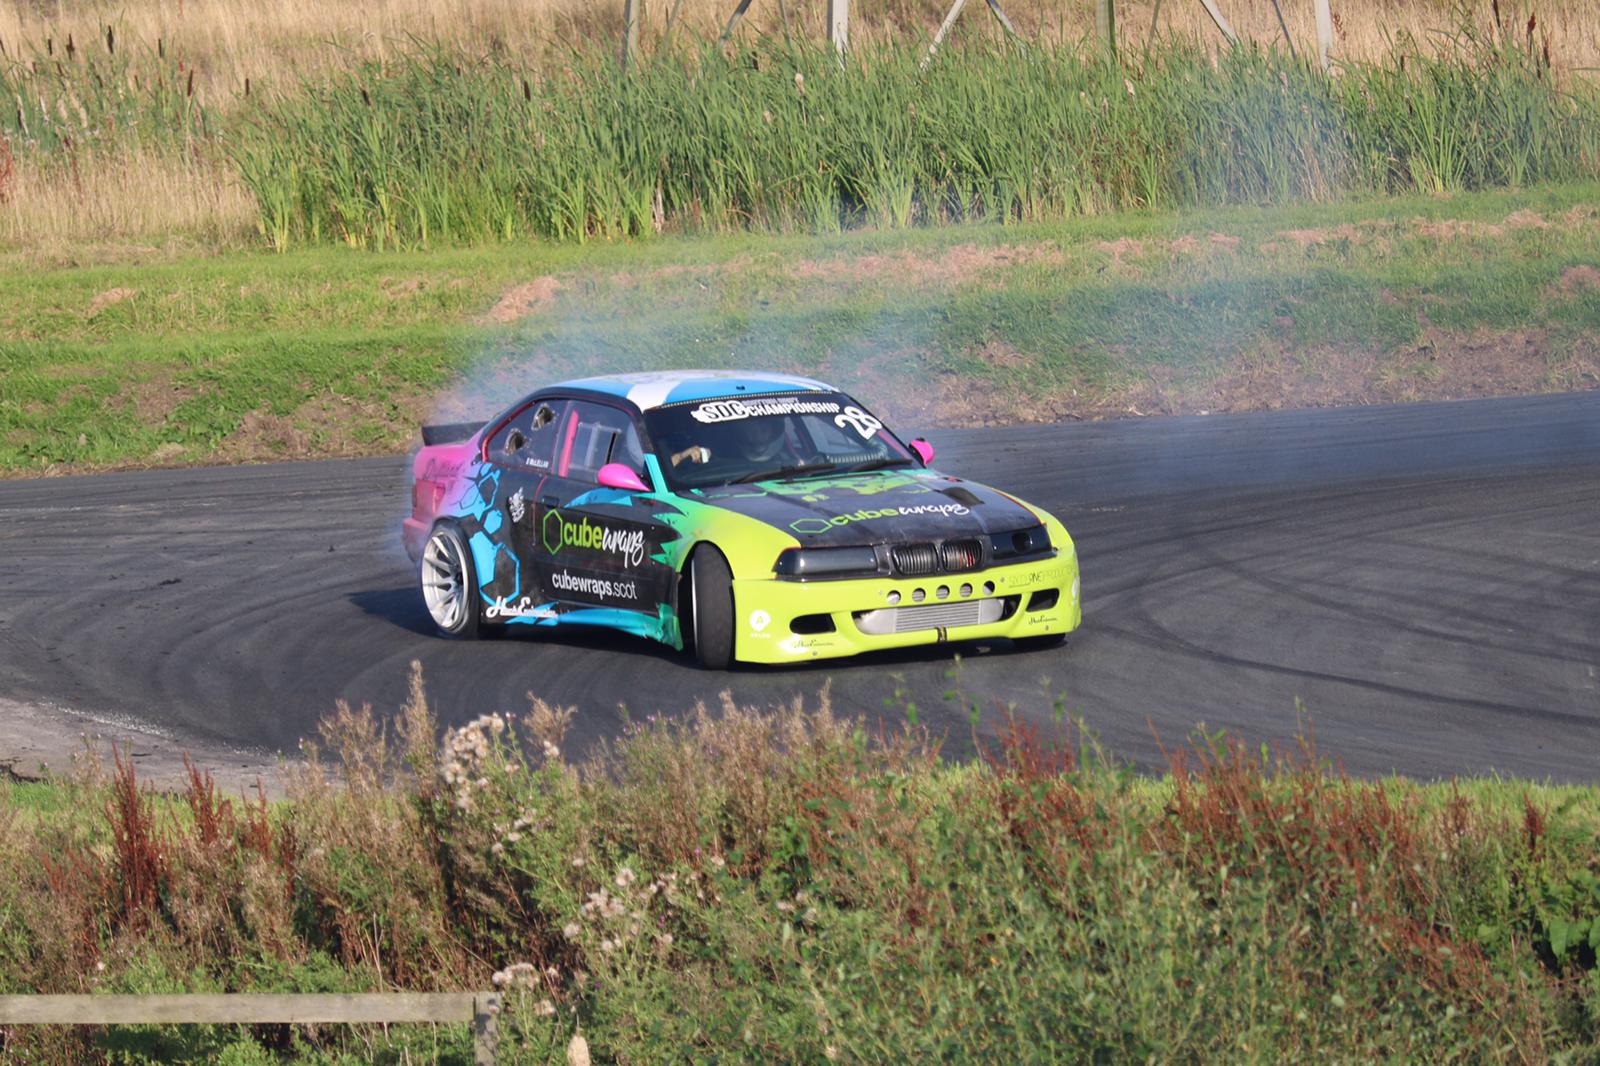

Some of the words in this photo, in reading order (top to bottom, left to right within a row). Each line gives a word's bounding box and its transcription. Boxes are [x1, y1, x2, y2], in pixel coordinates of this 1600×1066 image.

[702, 401, 746, 420] SDC
[748, 402, 840, 416] CHAMPIONSHIP
[834, 406, 882, 440] 28
[552, 569, 637, 600] cubewraps.scot
